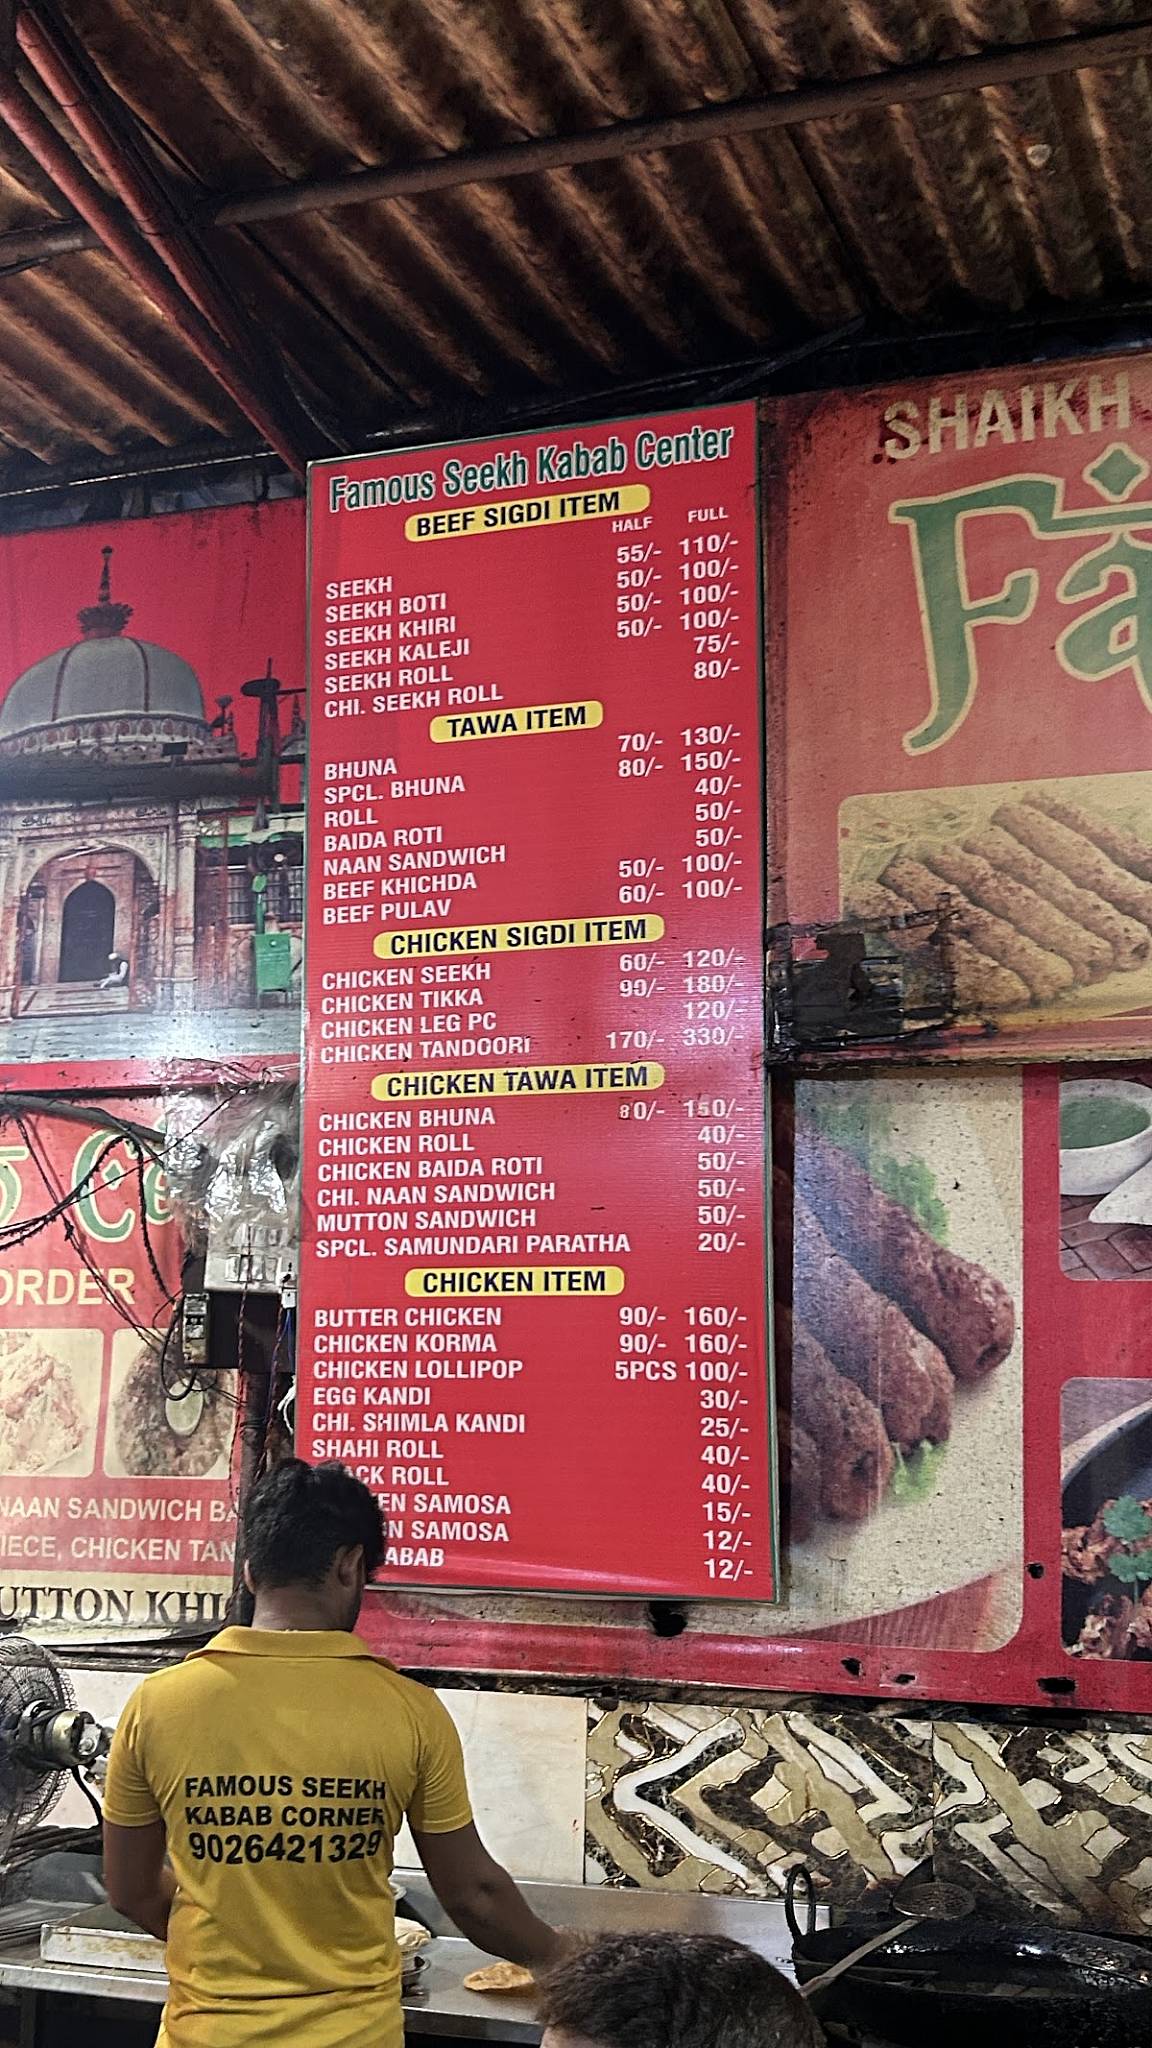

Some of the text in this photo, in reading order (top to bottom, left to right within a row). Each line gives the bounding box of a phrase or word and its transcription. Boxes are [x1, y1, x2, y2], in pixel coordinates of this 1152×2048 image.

[884, 371, 1131, 460] SHAIKH
[329, 426, 734, 513] Famous Seekh Kabab Center
[418, 492, 618, 536] BEEF SIGDI ITEM
[613, 507, 728, 532] HALF FULL
[326, 533, 737, 599] SEEKH 55/- 110/-
[326, 558, 738, 622] SEEKH BOTI 50/- 100/-
[326, 583, 738, 646] SEEKH KHIRI 50/- 100/-
[325, 608, 738, 670] SEEKH KALEJI 50/- 100/-
[325, 633, 738, 693] SEEKH ROLL 75/-
[325, 659, 739, 717] CHI. SEEKH ROLL 80/-
[447, 706, 585, 737] TAWA ITEM
[325, 725, 740, 780] BHUNA 70/- 130/-
[325, 750, 740, 804] SPCL. BHUNA 80/- 150/-
[325, 776, 741, 827] ROLL 40/-
[325, 801, 741, 852] BAIDA ROTI 50/-
[324, 827, 741, 875] NAAN SANDWICH 50/-
[324, 853, 741, 900] BEEF KHICHDA 50/- 100/-
[324, 878, 742, 924] BEEF PULAV 60/- 100/-
[392, 919, 645, 954] CHICKEN SIGDI ITEM
[323, 948, 746, 989] CHICKEN SEEKH 60/- 120/-
[322, 975, 744, 1014] CHICKEN TIKKA 90/- 180/-
[322, 1000, 746, 1039] CHICKEN LEG PC 120/-
[321, 1025, 744, 1063] CHICKEN TANDOORI 170/- 330/-
[388, 1066, 647, 1096] CHICKEN TAWA ITEM
[319, 1099, 744, 1131] CHICKEN BHUNA 80/- 150/-
[319, 1125, 746, 1156] CHICKEN ROLL 40/-
[319, 1152, 745, 1181] CHICKEN BAIDA ROTI 50/-
[318, 1178, 745, 1207] CHI. NAAN SANDWICH 50/-
[318, 1205, 745, 1231] MUTTON SANDWICH 50/-
[316, 1233, 744, 1257] SPCL. SAMUNDARI PARATHA 20/-
[424, 1271, 605, 1293] CHICKEN ITEM
[315, 1307, 746, 1327] BUTTER CHICKEN 90/- 160/-
[315, 1334, 746, 1354] CHICKEN KORMA 90/- 160/-
[314, 1360, 746, 1382] CHICKEN LOLLIPOP 5PCS 100/-
[314, 1387, 746, 1410] EGG KANDI 30/-
[313, 1413, 746, 1439] CHI. SHIMLA KANDI 25/-
[313, 1439, 746, 1466] SHAHI ROLL 40/-
[392, 1467, 448, 1485] ROLL
[702, 1474, 746, 1495] 40/-
[67, 1497, 201, 1522] SANDWICH
[414, 1494, 510, 1514] SAMOSA
[703, 1502, 746, 1523] 15/-
[71, 1537, 181, 1561] CHICKEN
[412, 1521, 508, 1541] SAMOSA
[704, 1531, 746, 1552] 12/-
[705, 1559, 746, 1581] 12/-
[185, 1775, 386, 1800] FAMOUS SEEKH
[185, 1806, 384, 1827] KABAB CORNER
[189, 1830, 383, 1864] 9026421329
